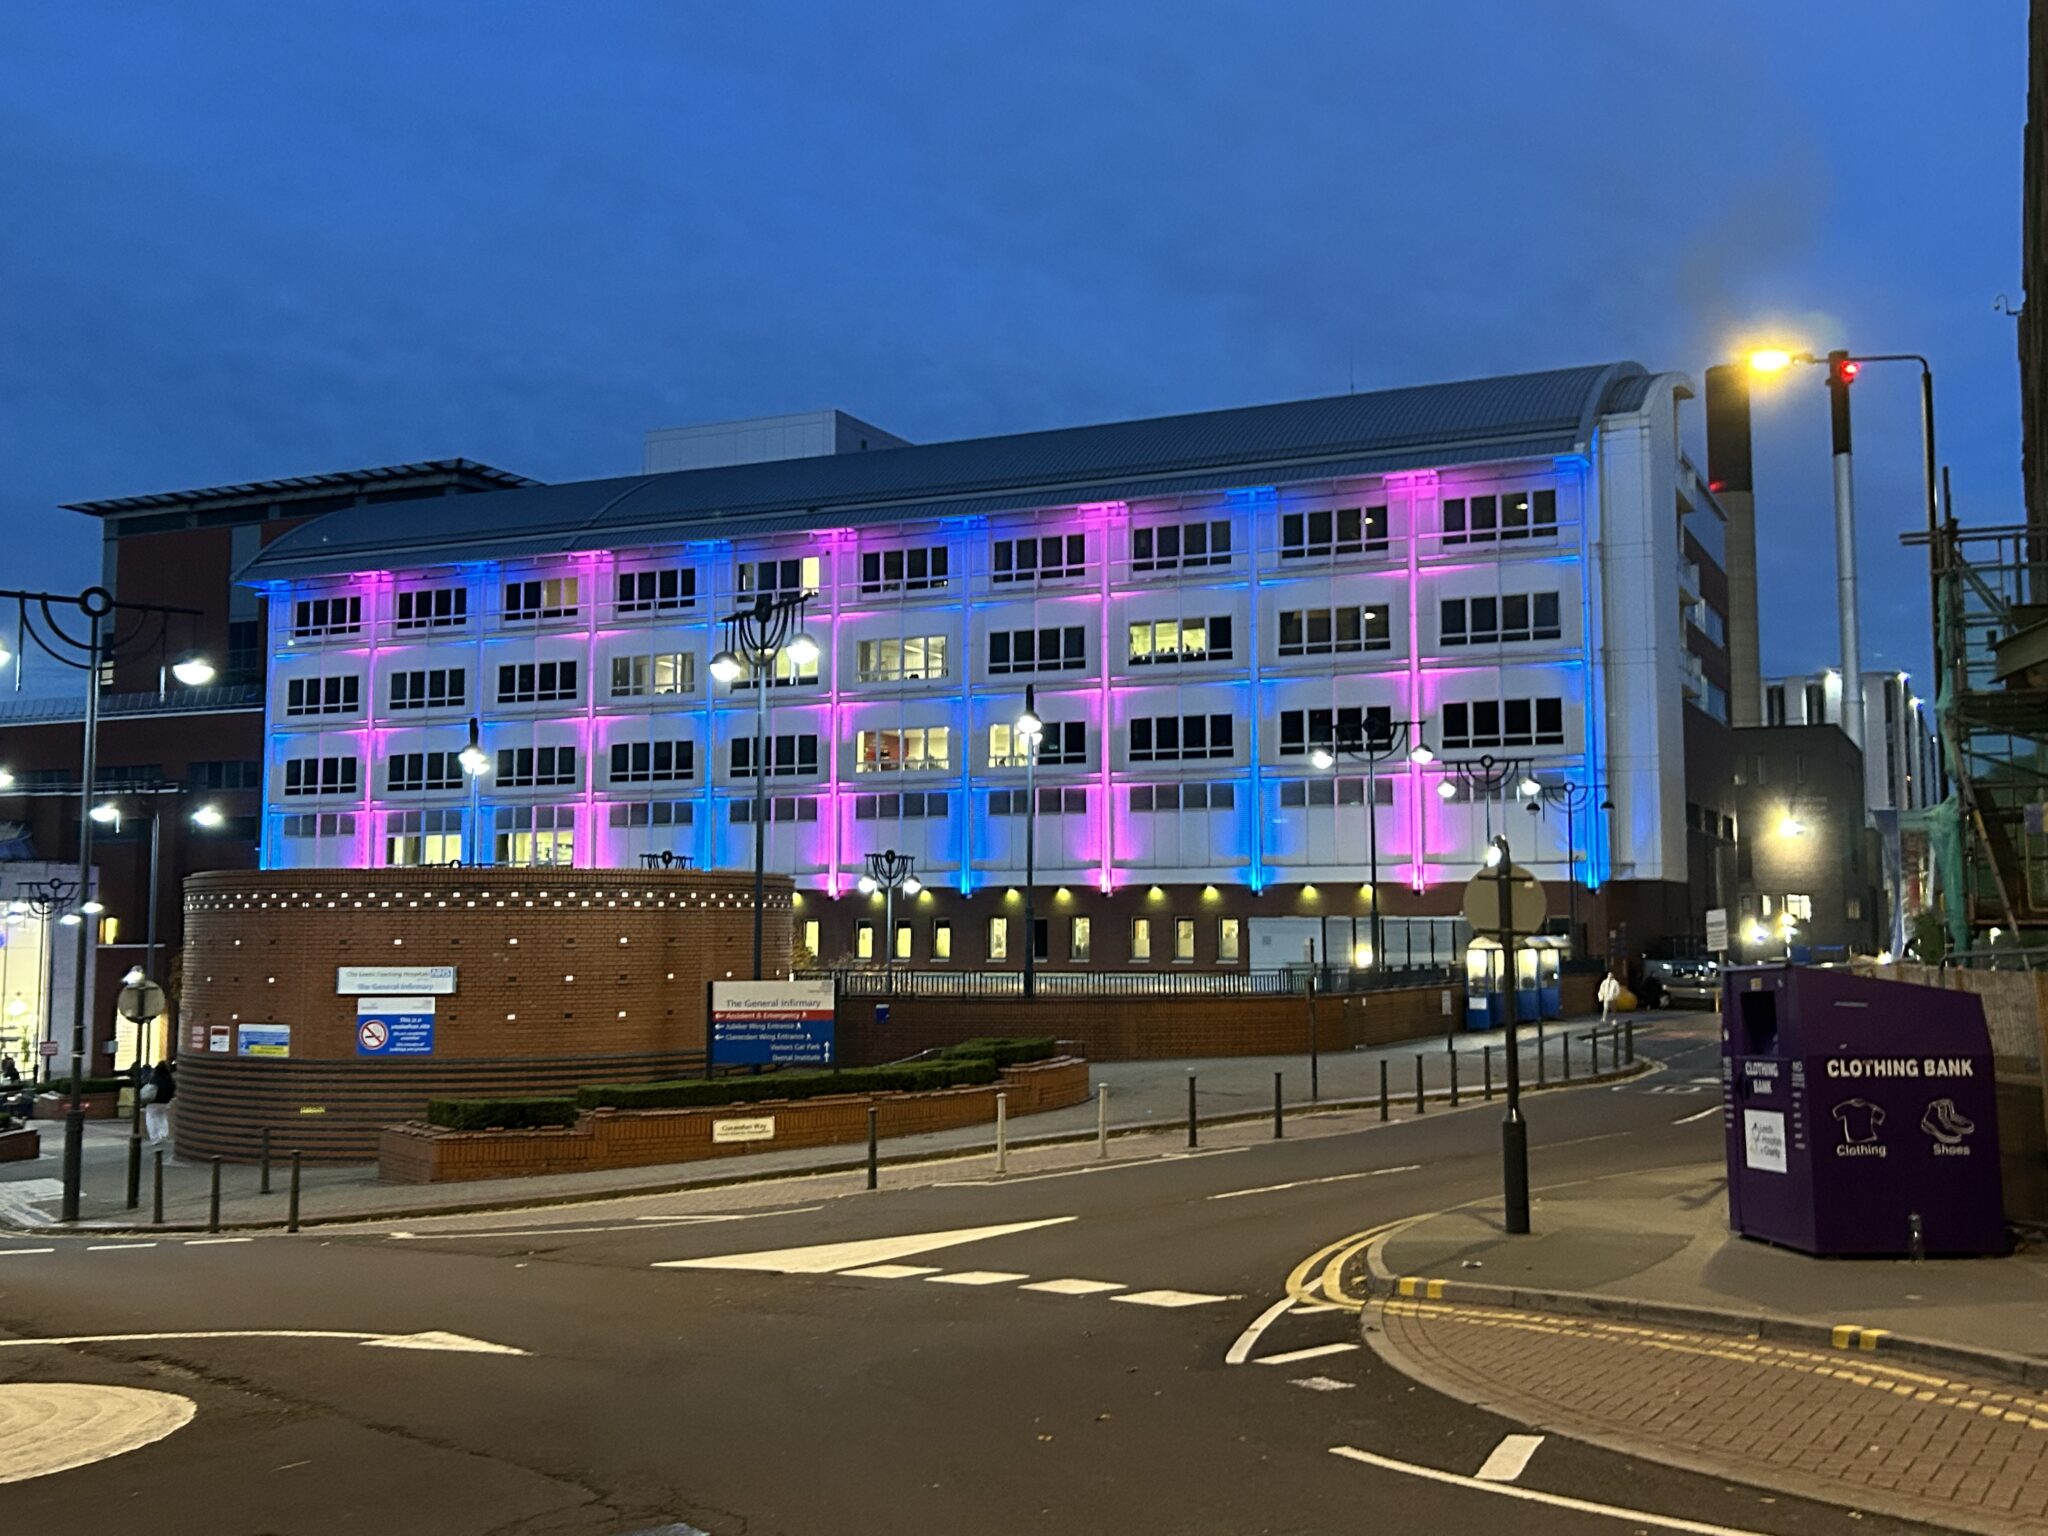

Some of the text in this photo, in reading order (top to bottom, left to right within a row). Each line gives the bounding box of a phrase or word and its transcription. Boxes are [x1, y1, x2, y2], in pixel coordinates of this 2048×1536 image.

[726, 999, 742, 1008] The
[744, 999, 778, 1008] General
[763, 1012, 800, 1021] Emergency
[767, 1022, 795, 1030] Entrance
[777, 1033, 805, 1041] Entrance
[1745, 1061, 1779, 1077] CLOTHING
[1827, 1059, 1973, 1077] CLOTHING BANK
[1753, 1079, 1773, 1094] BANK
[1836, 1143, 1887, 1157] Clothing
[1933, 1143, 1970, 1156] Shoes
